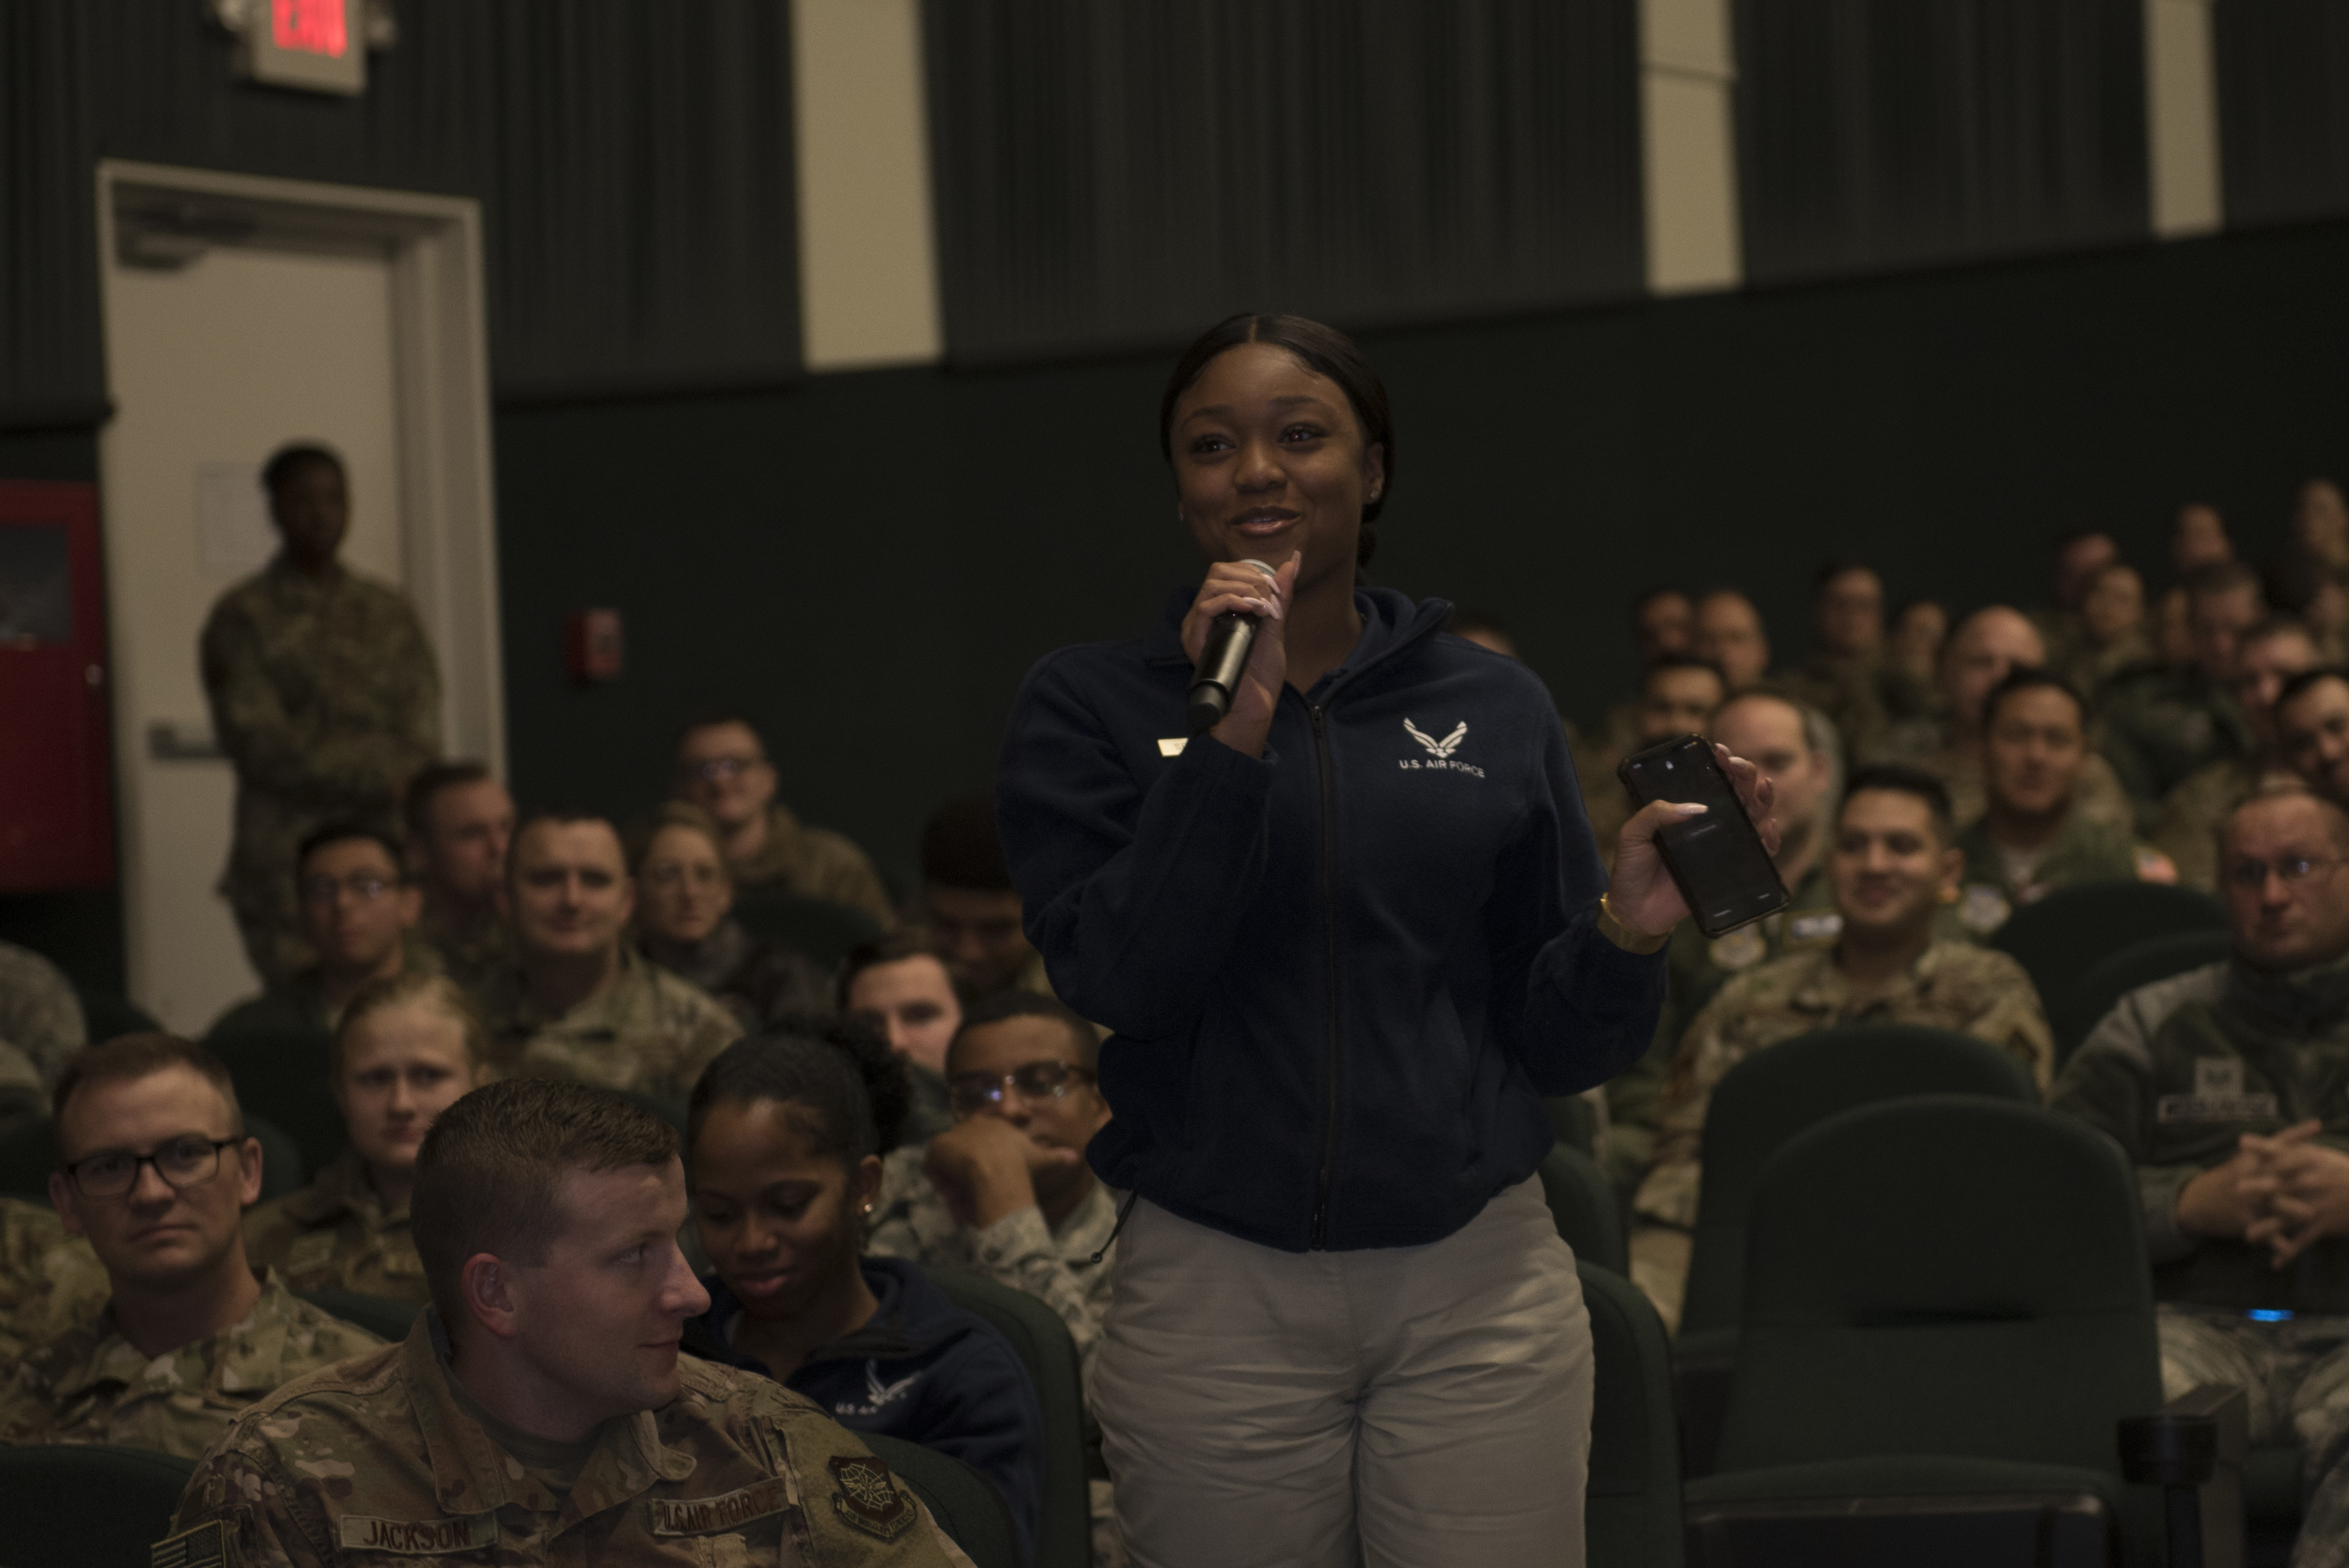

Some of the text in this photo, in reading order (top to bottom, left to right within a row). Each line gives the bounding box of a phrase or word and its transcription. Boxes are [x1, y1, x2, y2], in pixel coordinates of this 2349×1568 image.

[1399, 759, 1485, 778] U.S. AIR FORCE
[687, 1503, 714, 1530] AIR
[715, 1487, 783, 1524] FORCE
[363, 1521, 471, 1550] JACKSON
